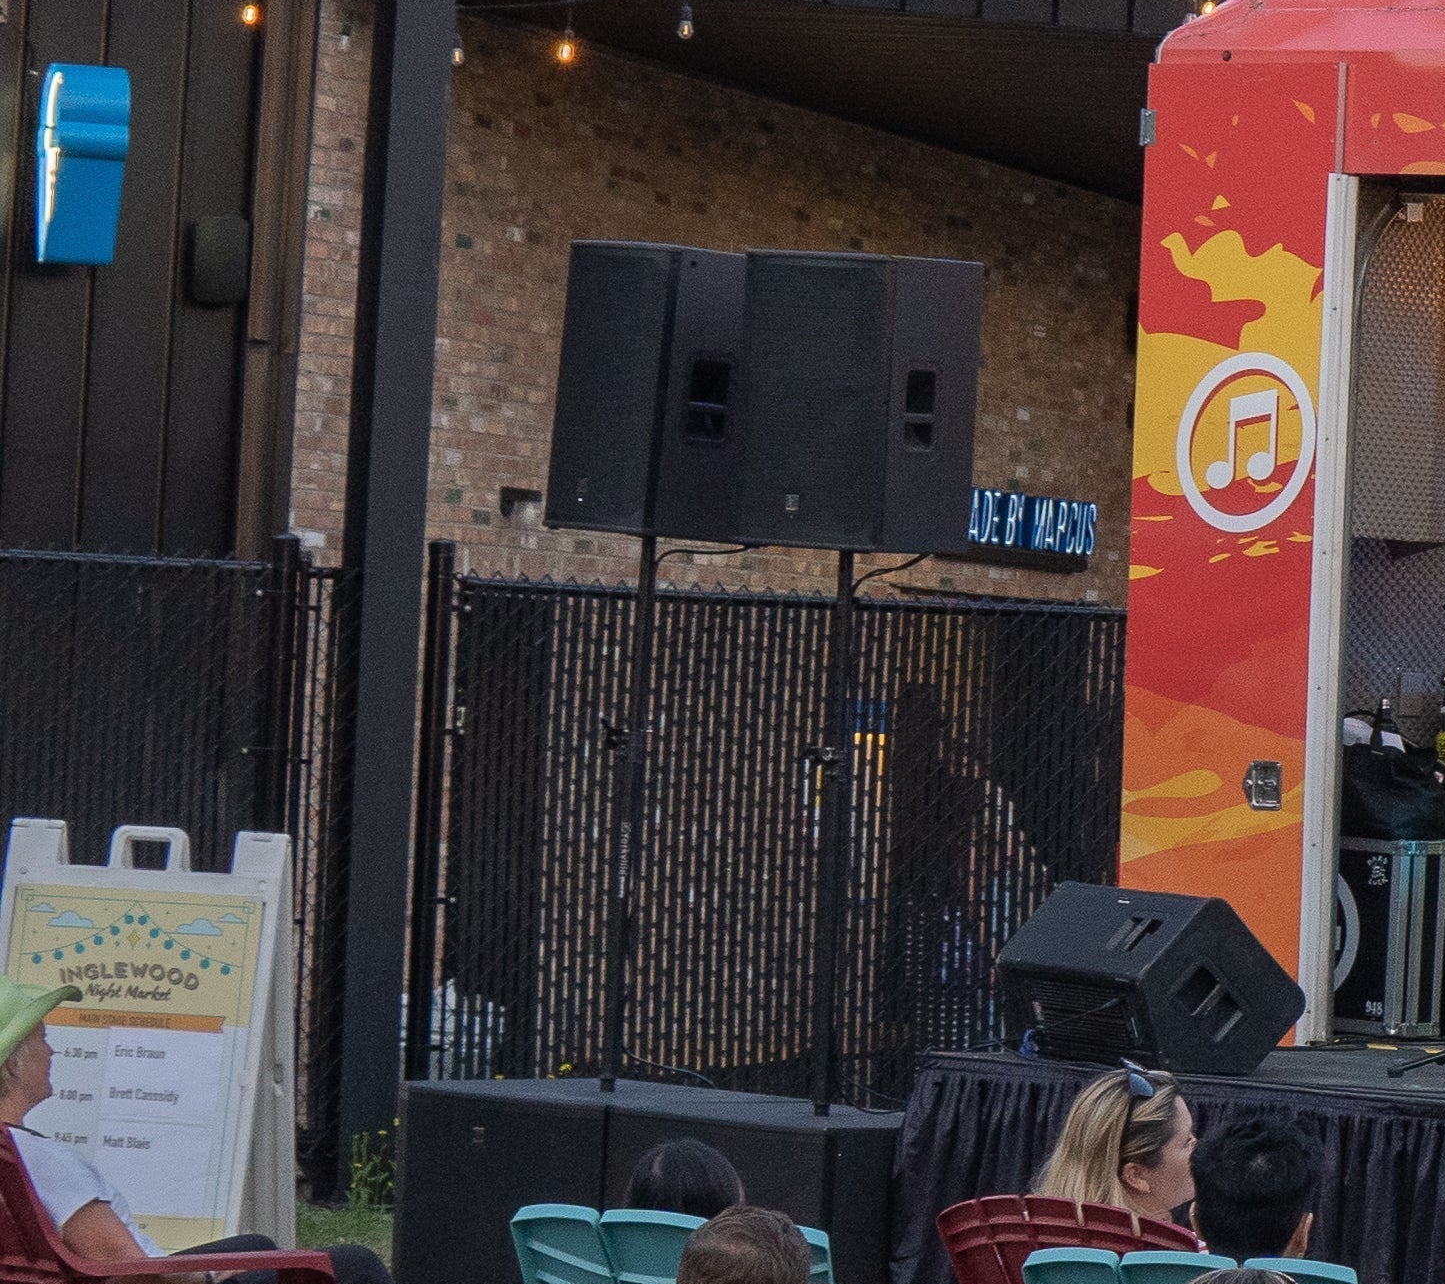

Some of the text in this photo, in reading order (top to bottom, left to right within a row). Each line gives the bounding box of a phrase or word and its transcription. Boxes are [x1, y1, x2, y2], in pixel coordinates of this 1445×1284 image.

[967, 489, 1001, 543] ADE
[1005, 494, 1026, 546] BY
[59, 962, 199, 990] INGLEWOOD
[84, 982, 172, 1002] Night Market
[129, 1017, 171, 1029] SCHEDULE
[84, 1051, 98, 1060] pm
[115, 1045, 165, 1059] Eric Braun
[79, 1093, 93, 1102] pm
[109, 1087, 132, 1099] Brett
[74, 1135, 88, 1145] pm
[102, 1135, 151, 1149] Matt Blais
